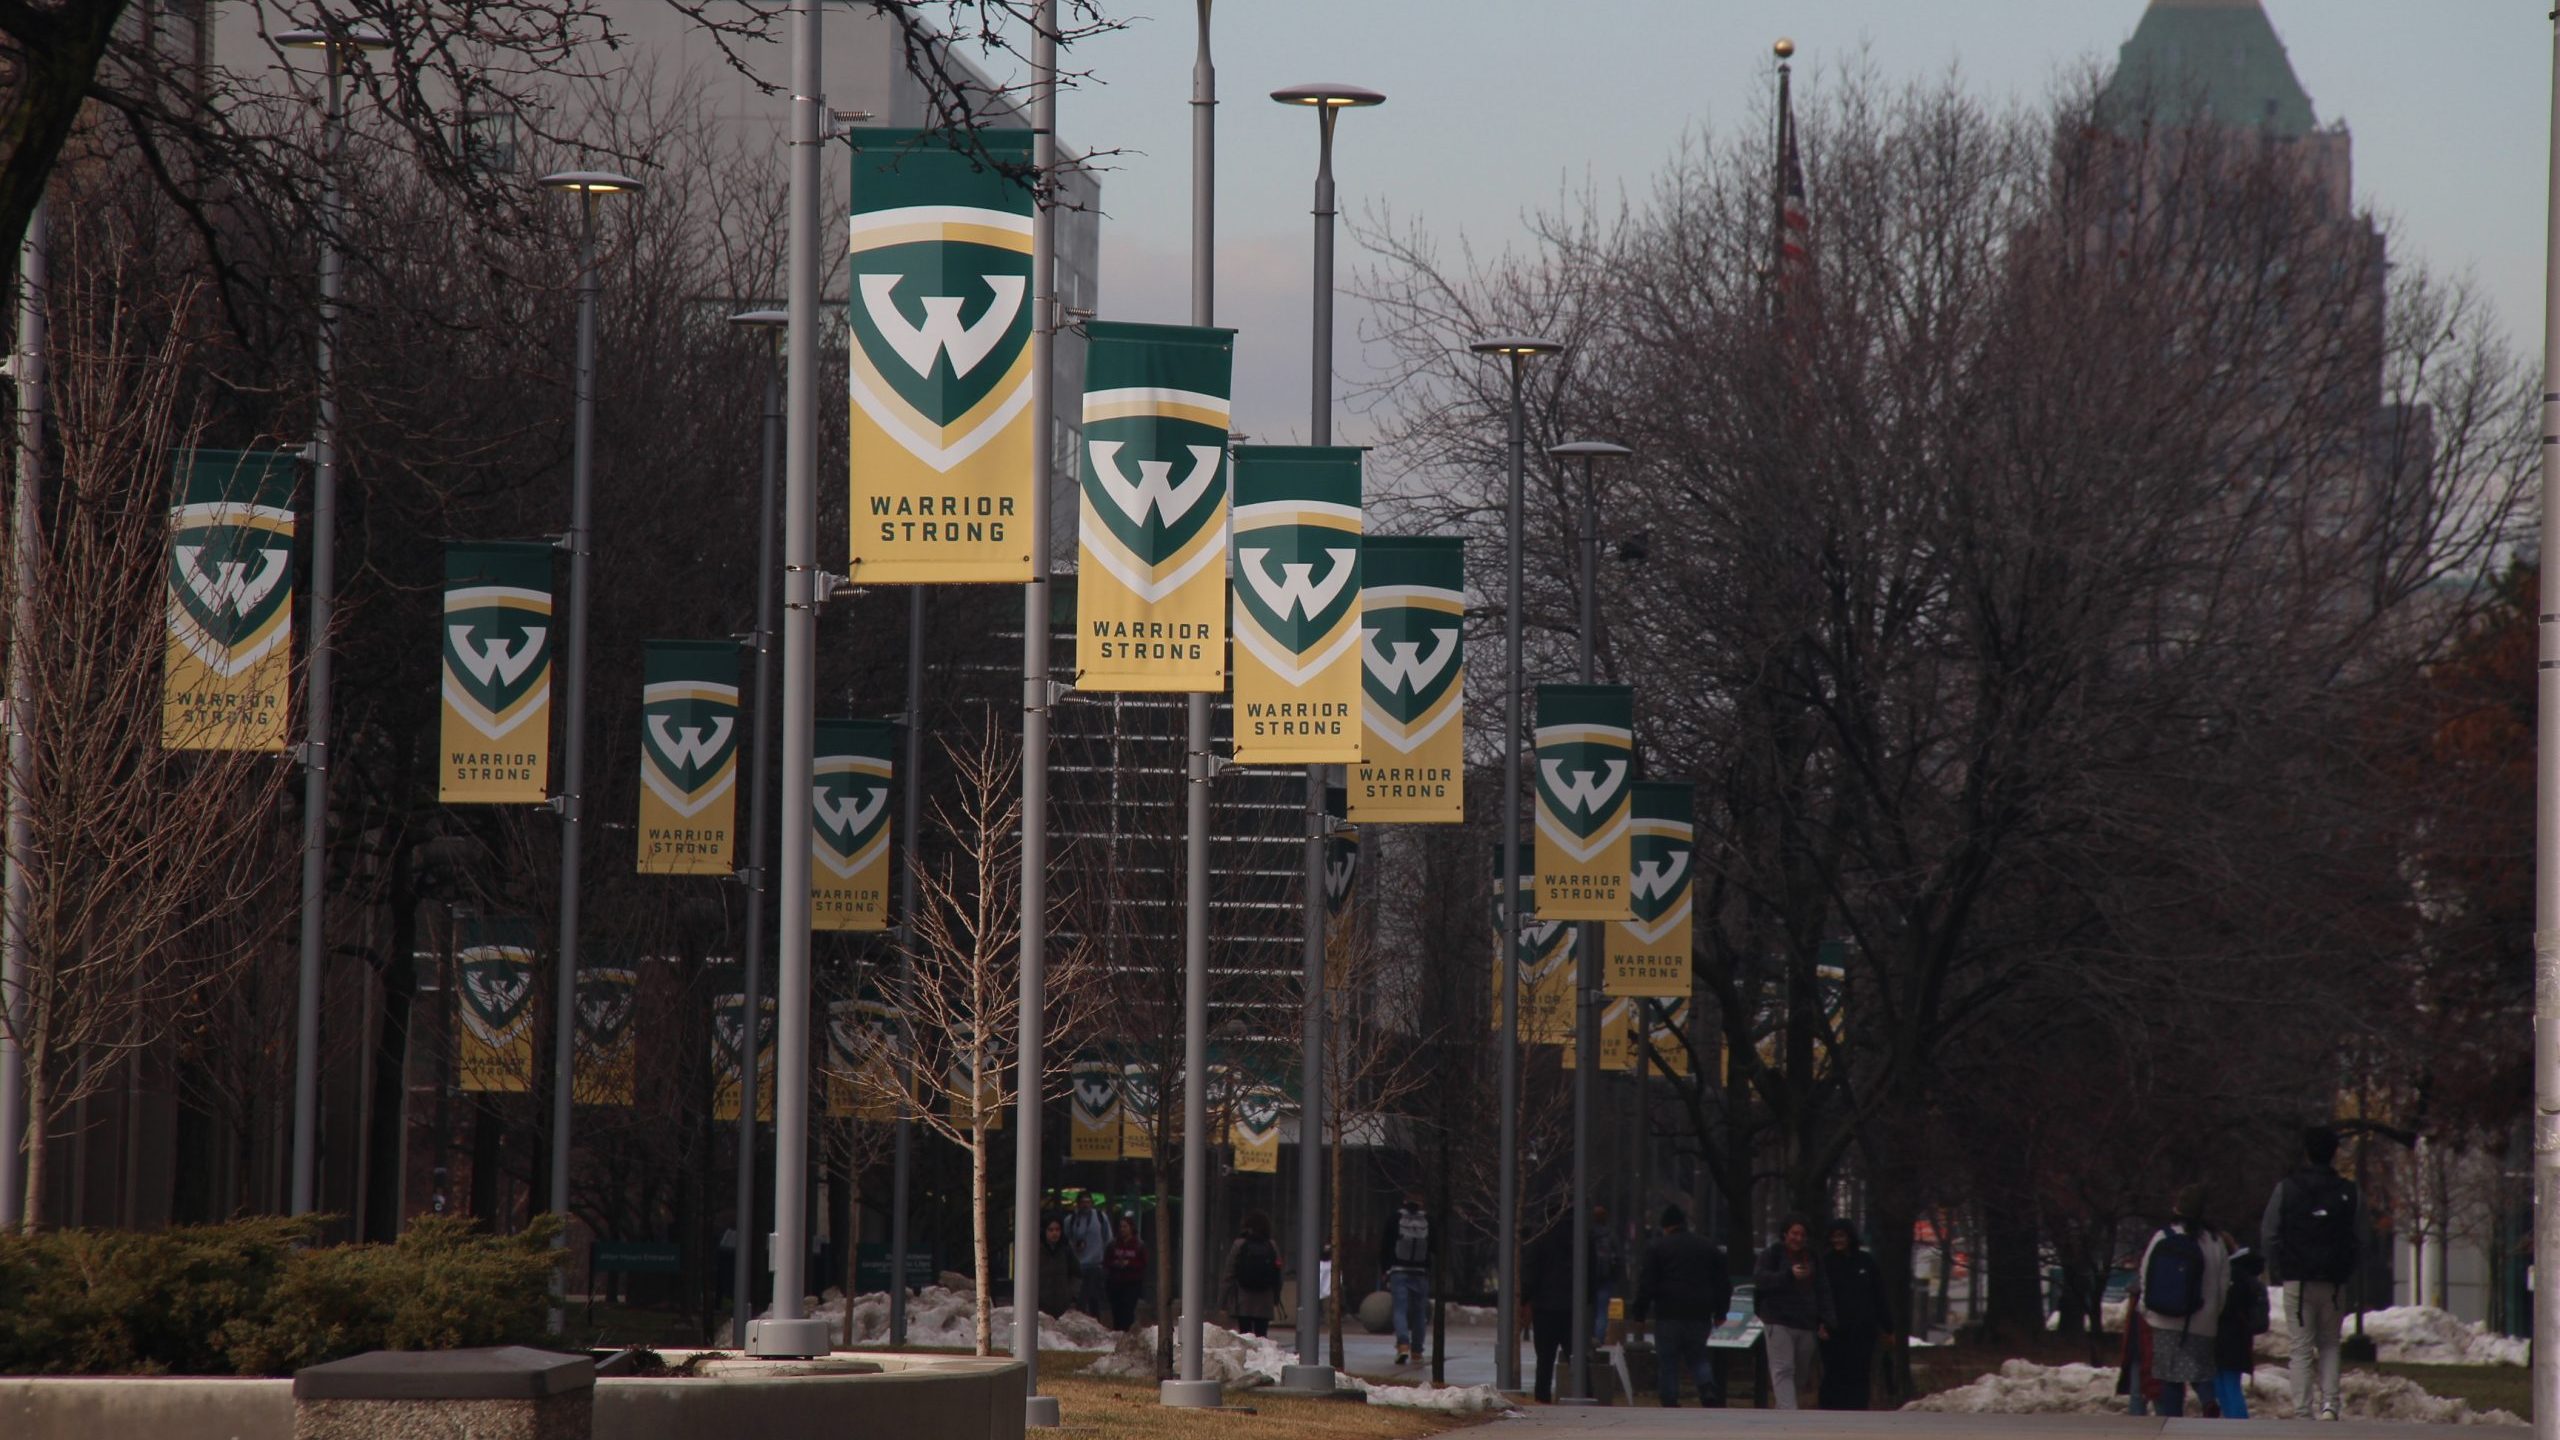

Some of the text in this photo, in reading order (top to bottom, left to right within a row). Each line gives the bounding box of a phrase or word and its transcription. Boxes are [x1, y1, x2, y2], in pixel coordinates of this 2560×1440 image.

[858, 274, 1026, 380] W
[1089, 440, 1221, 528] W
[870, 496, 1014, 516] WARRIOR
[881, 522, 1004, 542] STRONG
[1239, 548, 1356, 621] W
[1093, 621, 1209, 640] WARRIOR
[449, 625, 546, 687] W
[1101, 641, 1201, 660] STRONG
[1362, 628, 1459, 695] W
[177, 691, 276, 709] WARRIOR
[184, 709, 268, 726] STRONG
[1247, 703, 1348, 717] WARRIOR
[1254, 720, 1341, 735] STRONG
[647, 714, 734, 770] W
[451, 752, 537, 766] WARRIOR
[457, 767, 531, 780] STRONG
[1359, 768, 1451, 781] WARRIOR
[1366, 784, 1445, 797] STRONG
[1540, 759, 1627, 815] W
[812, 786, 888, 835] W
[648, 828, 724, 841] WARRIOR
[653, 841, 718, 854] STRONG
[1545, 874, 1621, 886] WARRIOR
[811, 888, 880, 901] WARRIOR
[1550, 888, 1615, 900] STRONG
[816, 901, 874, 912] STRONG
[1614, 954, 1683, 966] WARRIOR
[1619, 967, 1678, 978] STRONG
